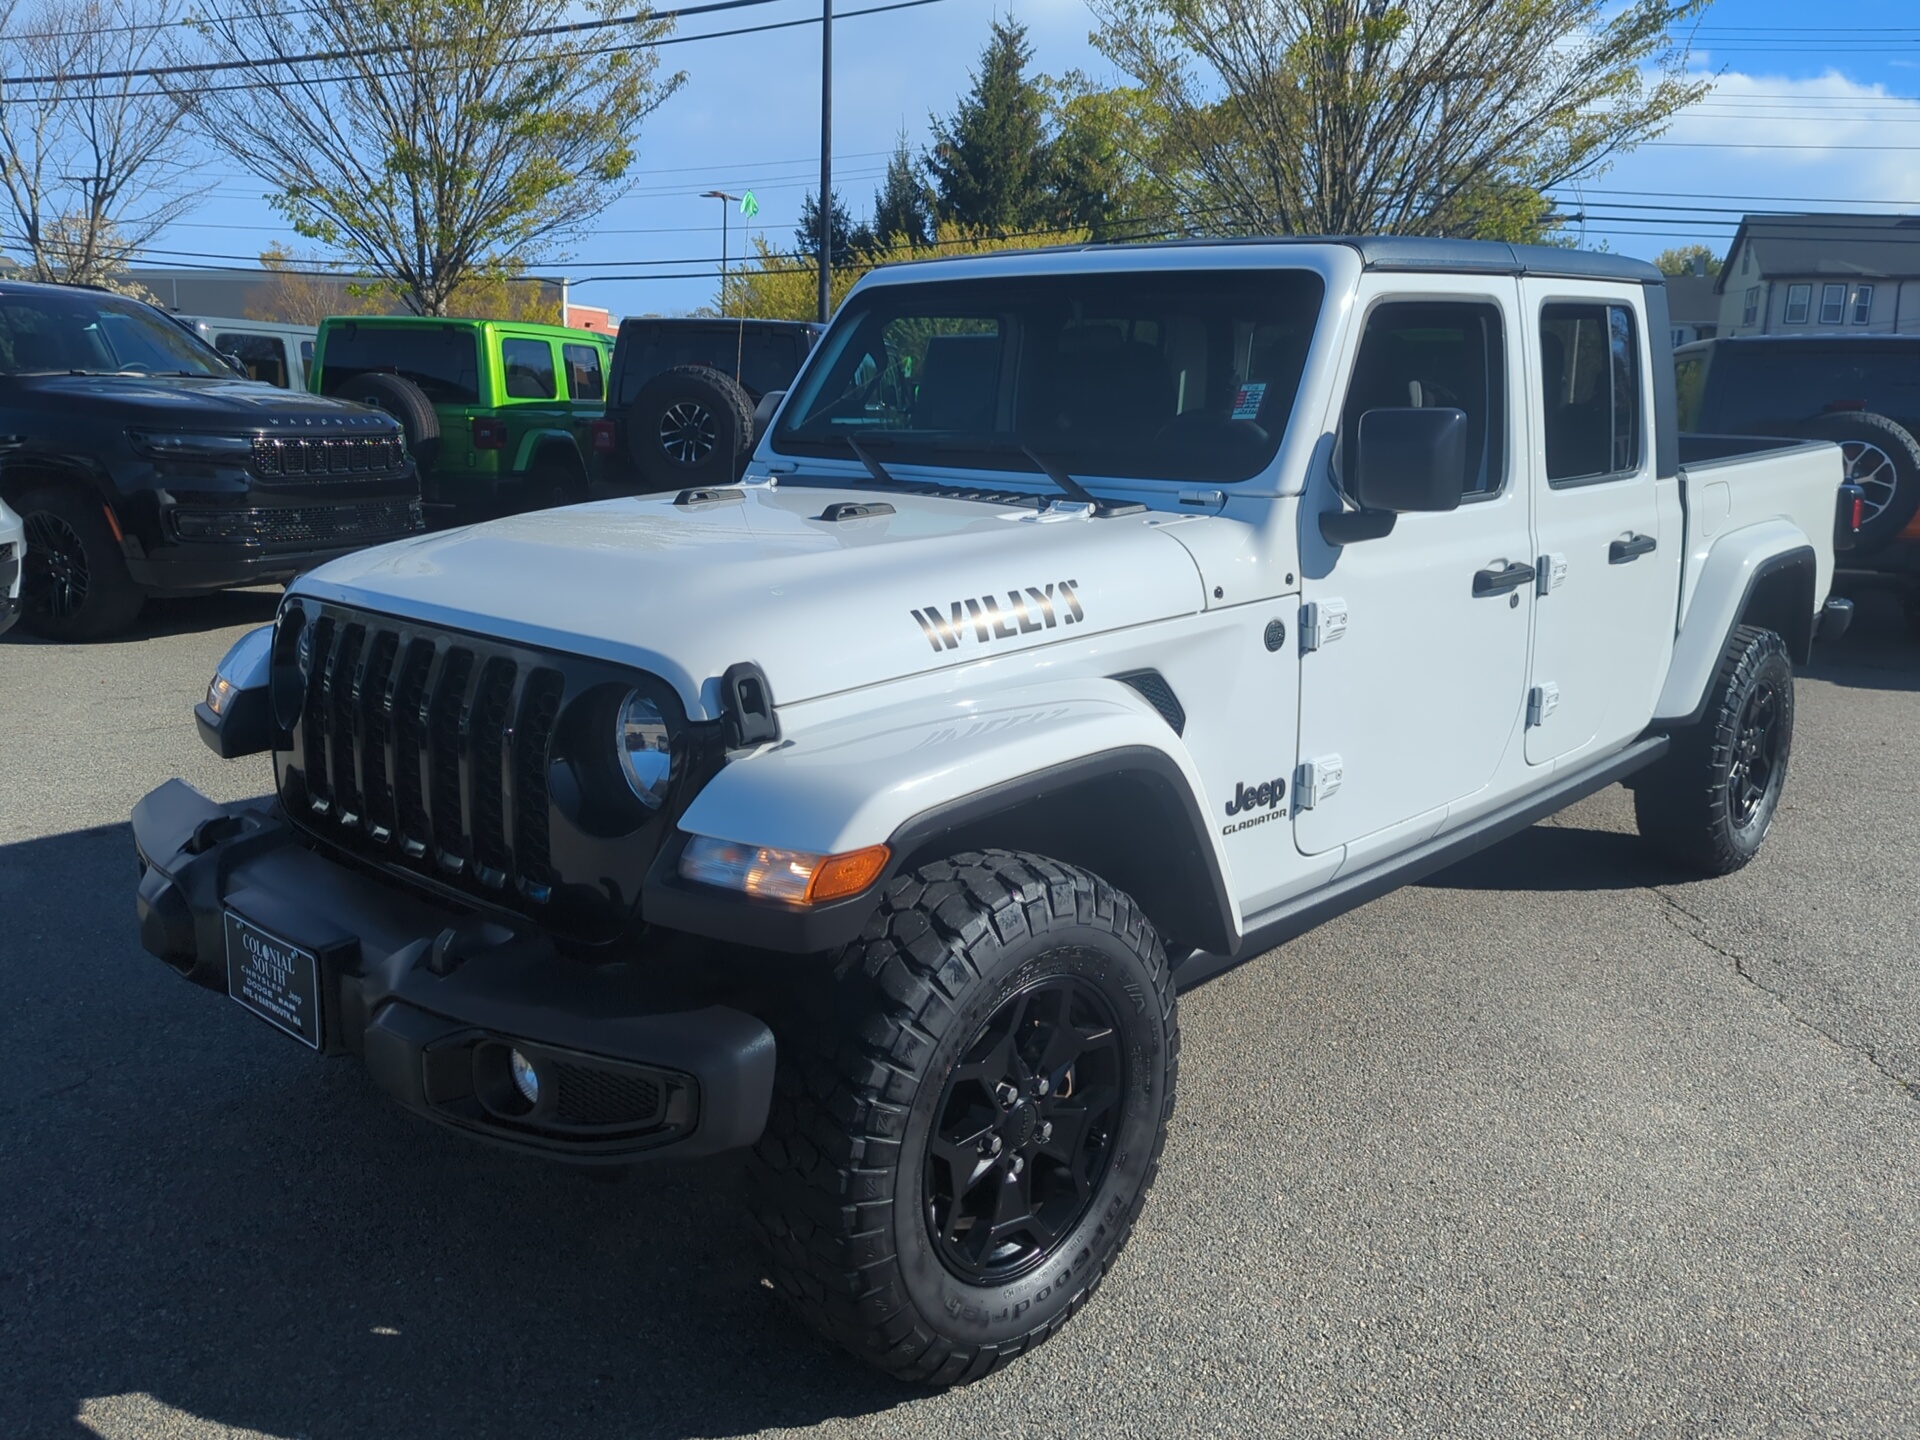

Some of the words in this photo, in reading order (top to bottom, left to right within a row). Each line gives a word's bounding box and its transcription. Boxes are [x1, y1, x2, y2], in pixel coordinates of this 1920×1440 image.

[910, 579, 1084, 653] WILLYS
[1225, 777, 1286, 817] Jeep
[1222, 808, 1287, 836] GLADIATOR
[242, 933, 296, 975] COLONIAL
[252, 953, 287, 987] SOUTH
[240, 965, 283, 994] CHRYSLER
[246, 977, 273, 999] DODGE
